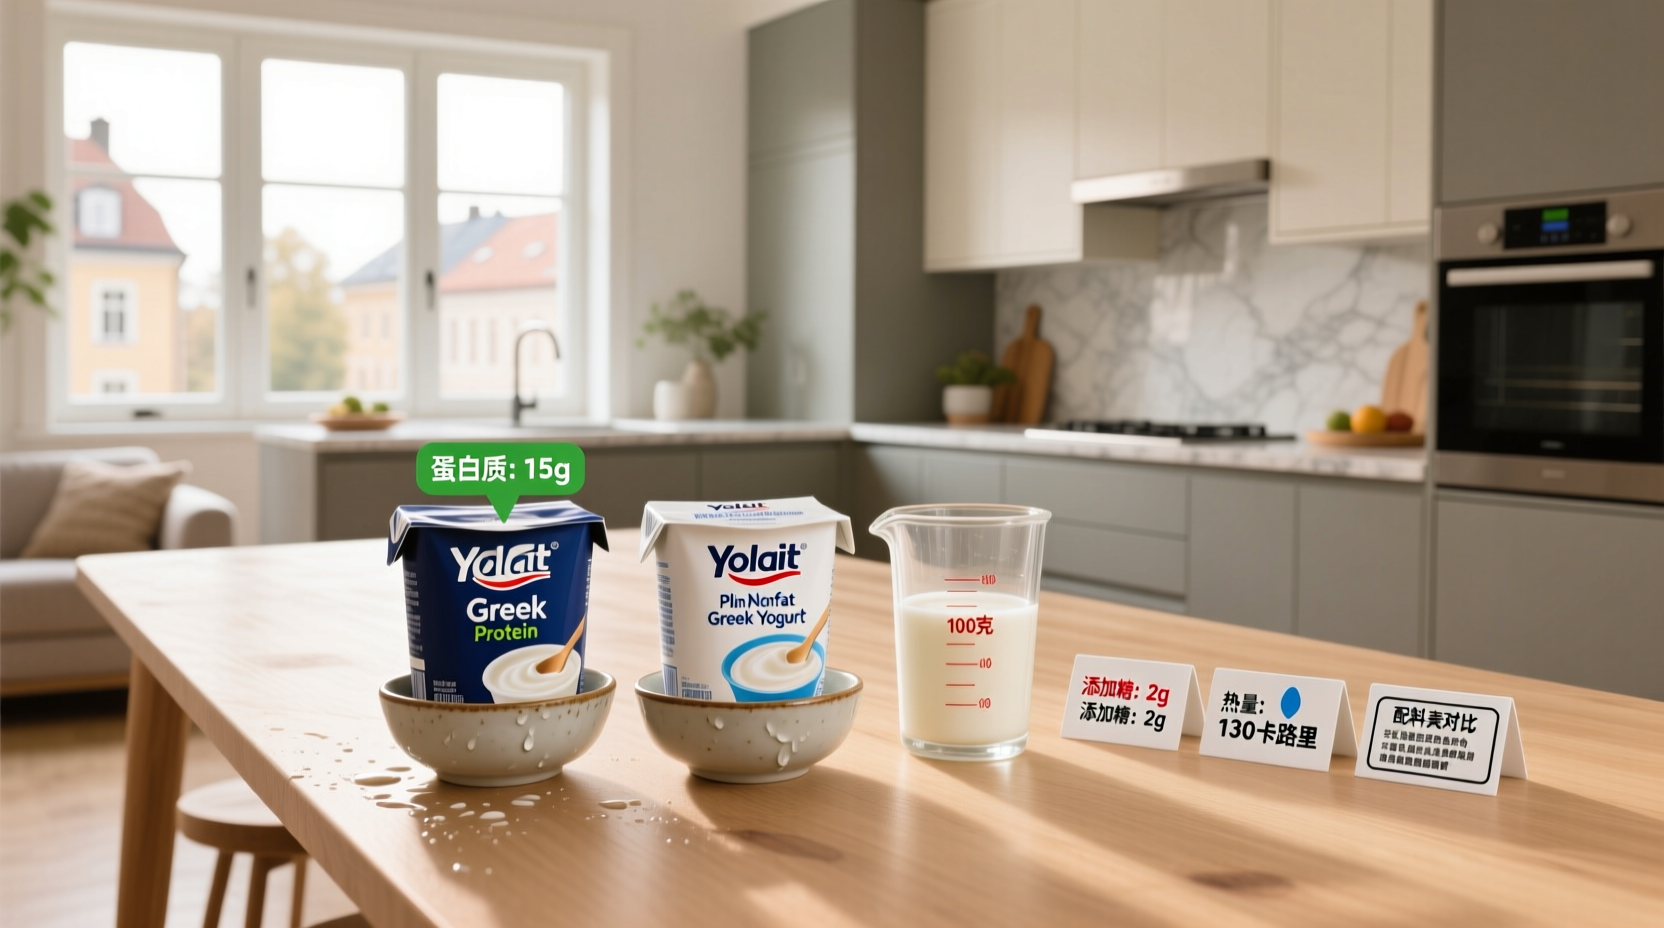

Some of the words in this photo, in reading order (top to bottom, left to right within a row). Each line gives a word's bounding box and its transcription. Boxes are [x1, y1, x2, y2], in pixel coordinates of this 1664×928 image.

[707, 543, 801, 578] Yolait
[466, 594, 547, 623] Greek
[707, 610, 754, 626] Greek
[756, 608, 807, 629] Yogurt
[474, 622, 538, 642] Protein
[947, 615, 994, 635] 100克
[1081, 675, 1139, 701] 添加糖:
[1145, 683, 1170, 708] 2g
[1220, 690, 1265, 715] 热量:
[1143, 709, 1167, 732] 2g
[1218, 718, 1318, 749] 130卡路里
